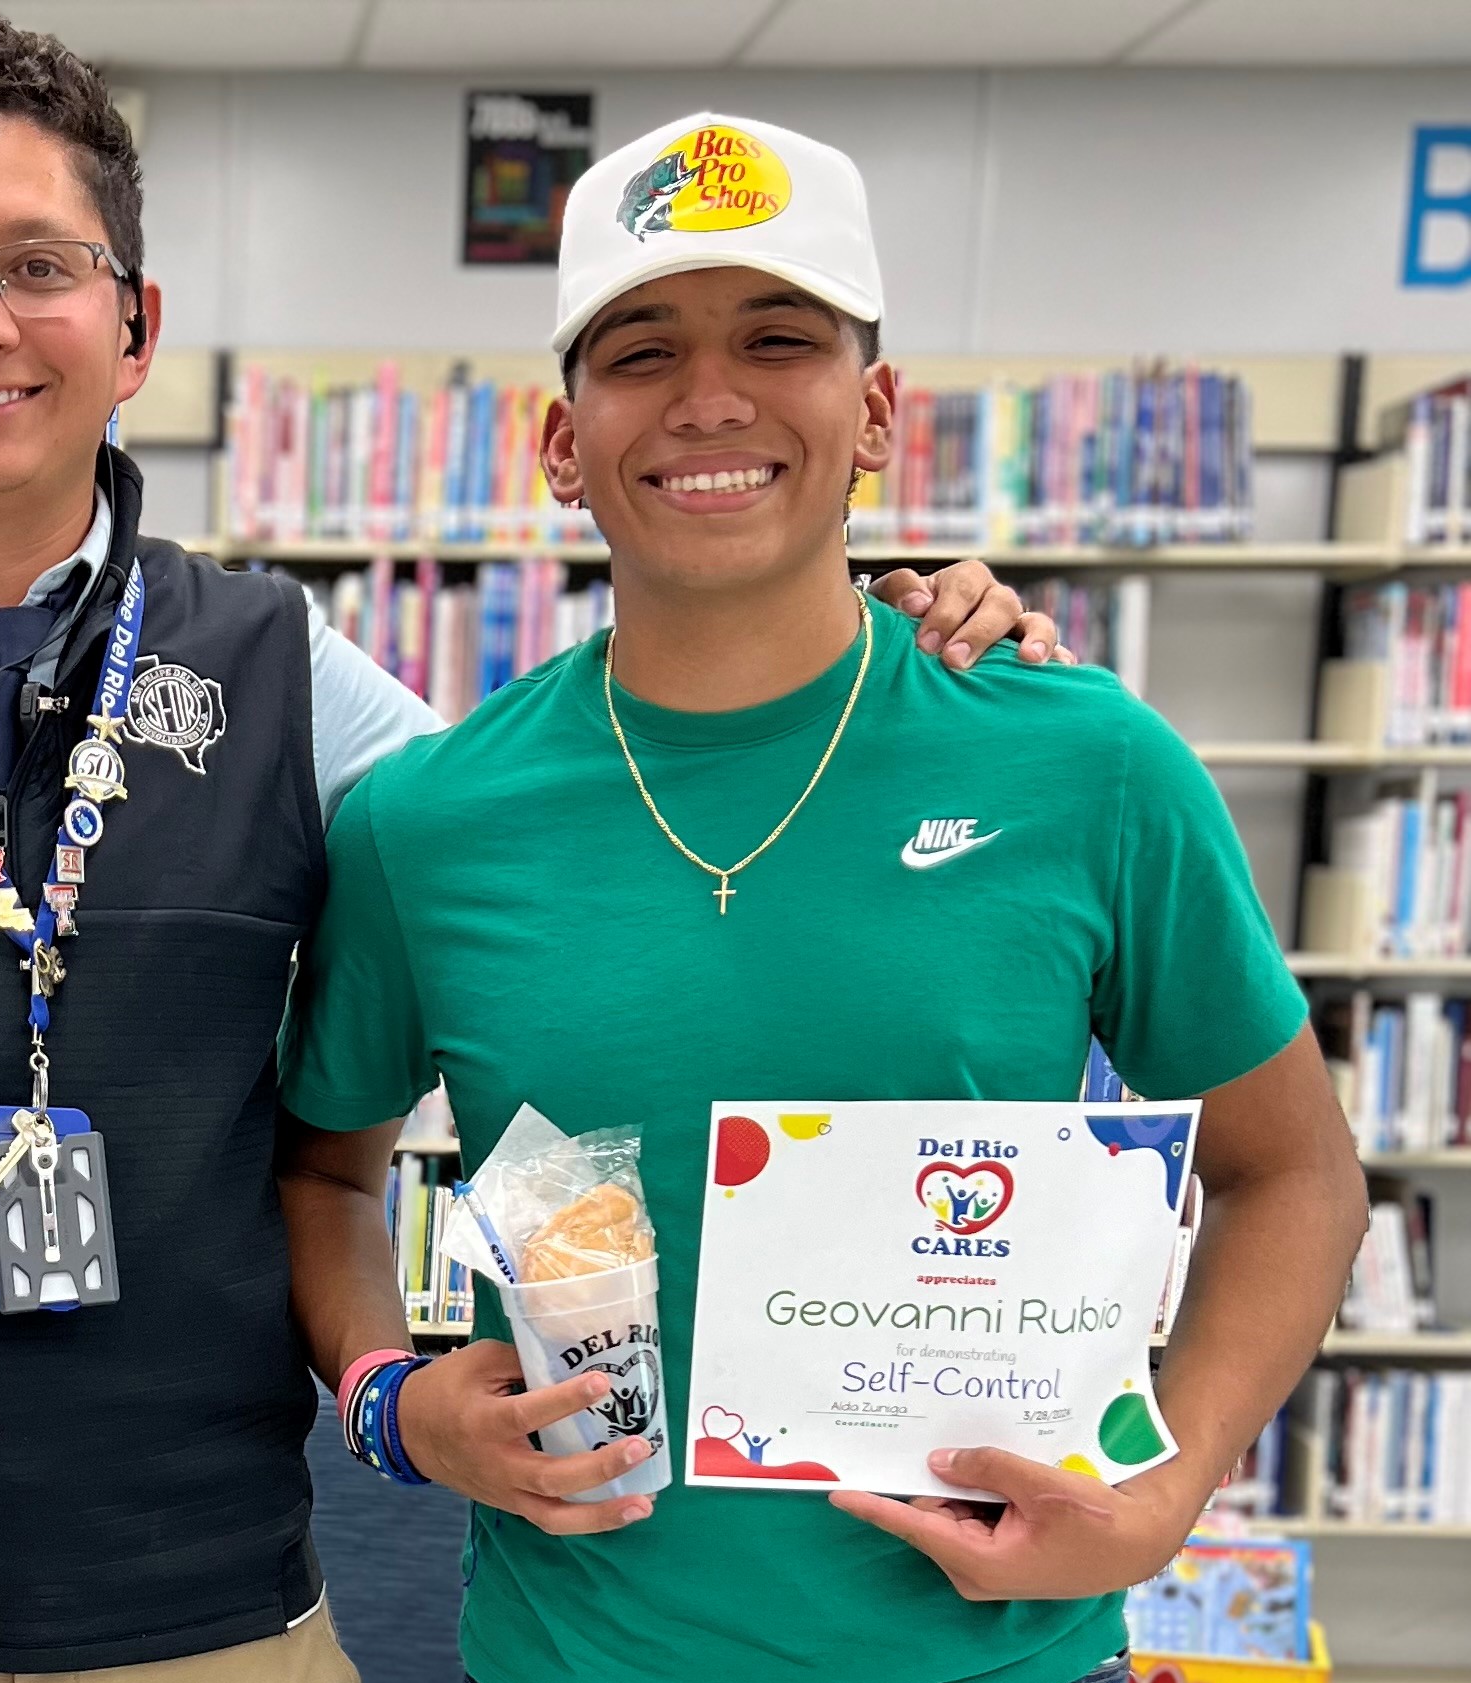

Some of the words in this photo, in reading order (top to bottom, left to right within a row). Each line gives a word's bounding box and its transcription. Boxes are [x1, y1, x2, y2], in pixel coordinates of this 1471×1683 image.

[692, 129, 761, 160] Bass
[696, 158, 746, 187] Pro
[694, 184, 780, 216] Shops
[110, 624, 133, 668] Del
[100, 667, 125, 709] Rio
[172, 668, 193, 684] DEL
[190, 680, 206, 699] RIO
[77, 752, 113, 779] 50
[915, 818, 979, 850] NIKE
[917, 1138, 964, 1157] Del
[971, 1139, 1019, 1158] Rio
[911, 1236, 1010, 1257] CARES
[916, 1274, 997, 1286] appreciates
[766, 1290, 1003, 1334] Geovanni
[1018, 1296, 1122, 1335] Rubio
[559, 1329, 625, 1370] DEL
[895, 1343, 914, 1357] for
[919, 1343, 1017, 1366] demonstrating
[841, 1361, 1062, 1400] Self-Control
